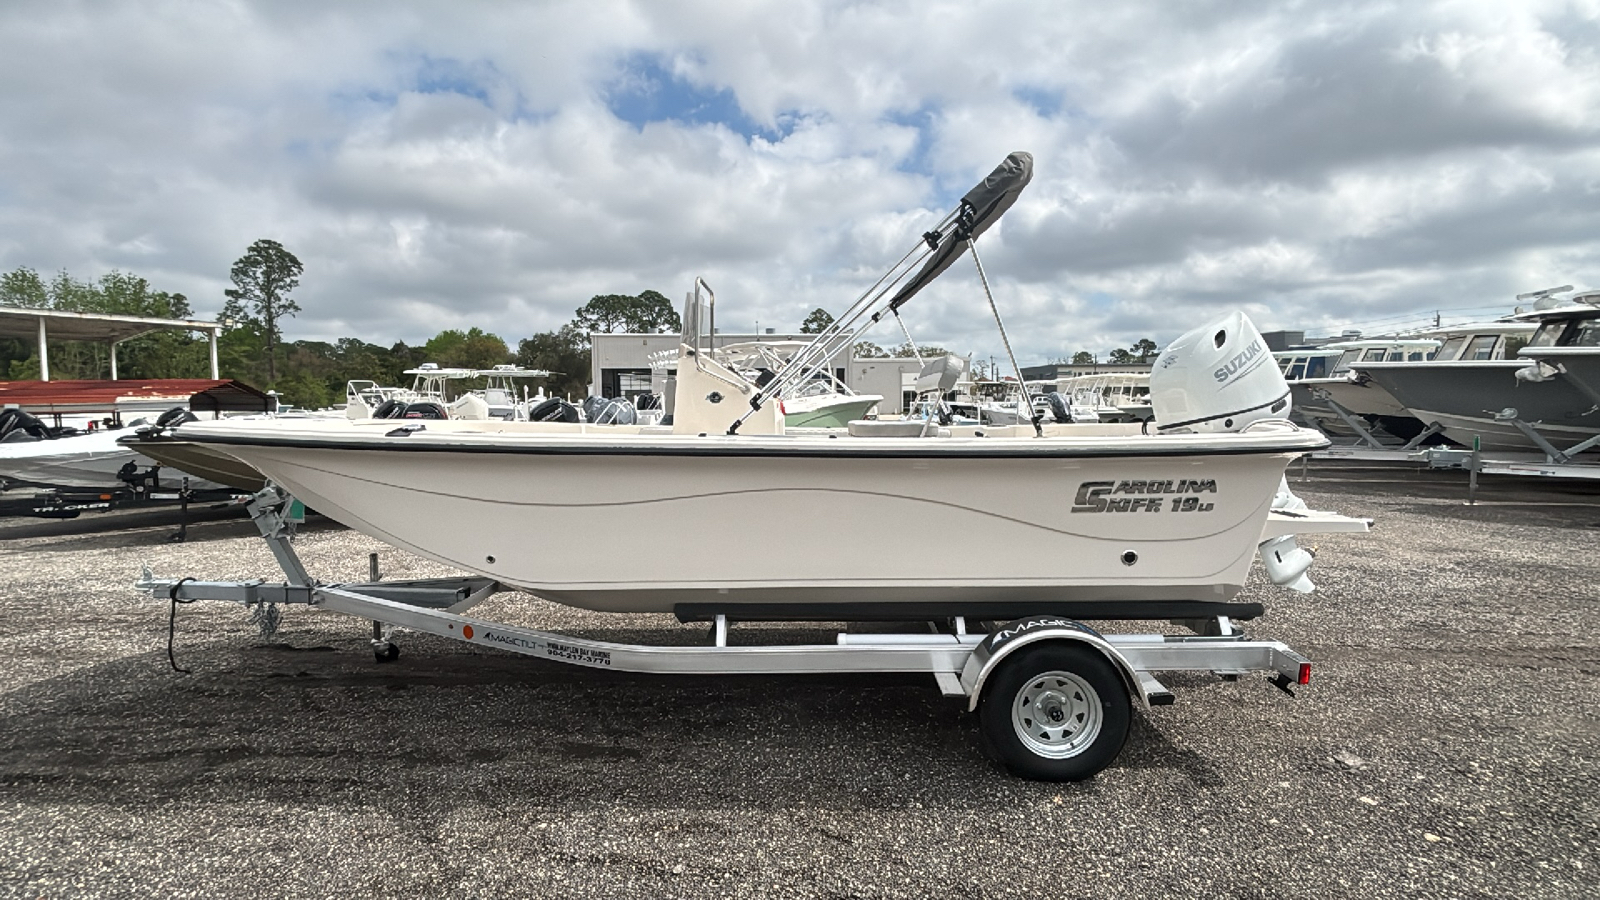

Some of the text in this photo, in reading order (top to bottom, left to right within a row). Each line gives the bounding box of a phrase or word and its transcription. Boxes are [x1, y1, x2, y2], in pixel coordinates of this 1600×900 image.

[1214, 339, 1262, 382] SUZUKI
[1074, 479, 1218, 505] CAROLINA
[490, 634, 537, 649] MAGICTILT
